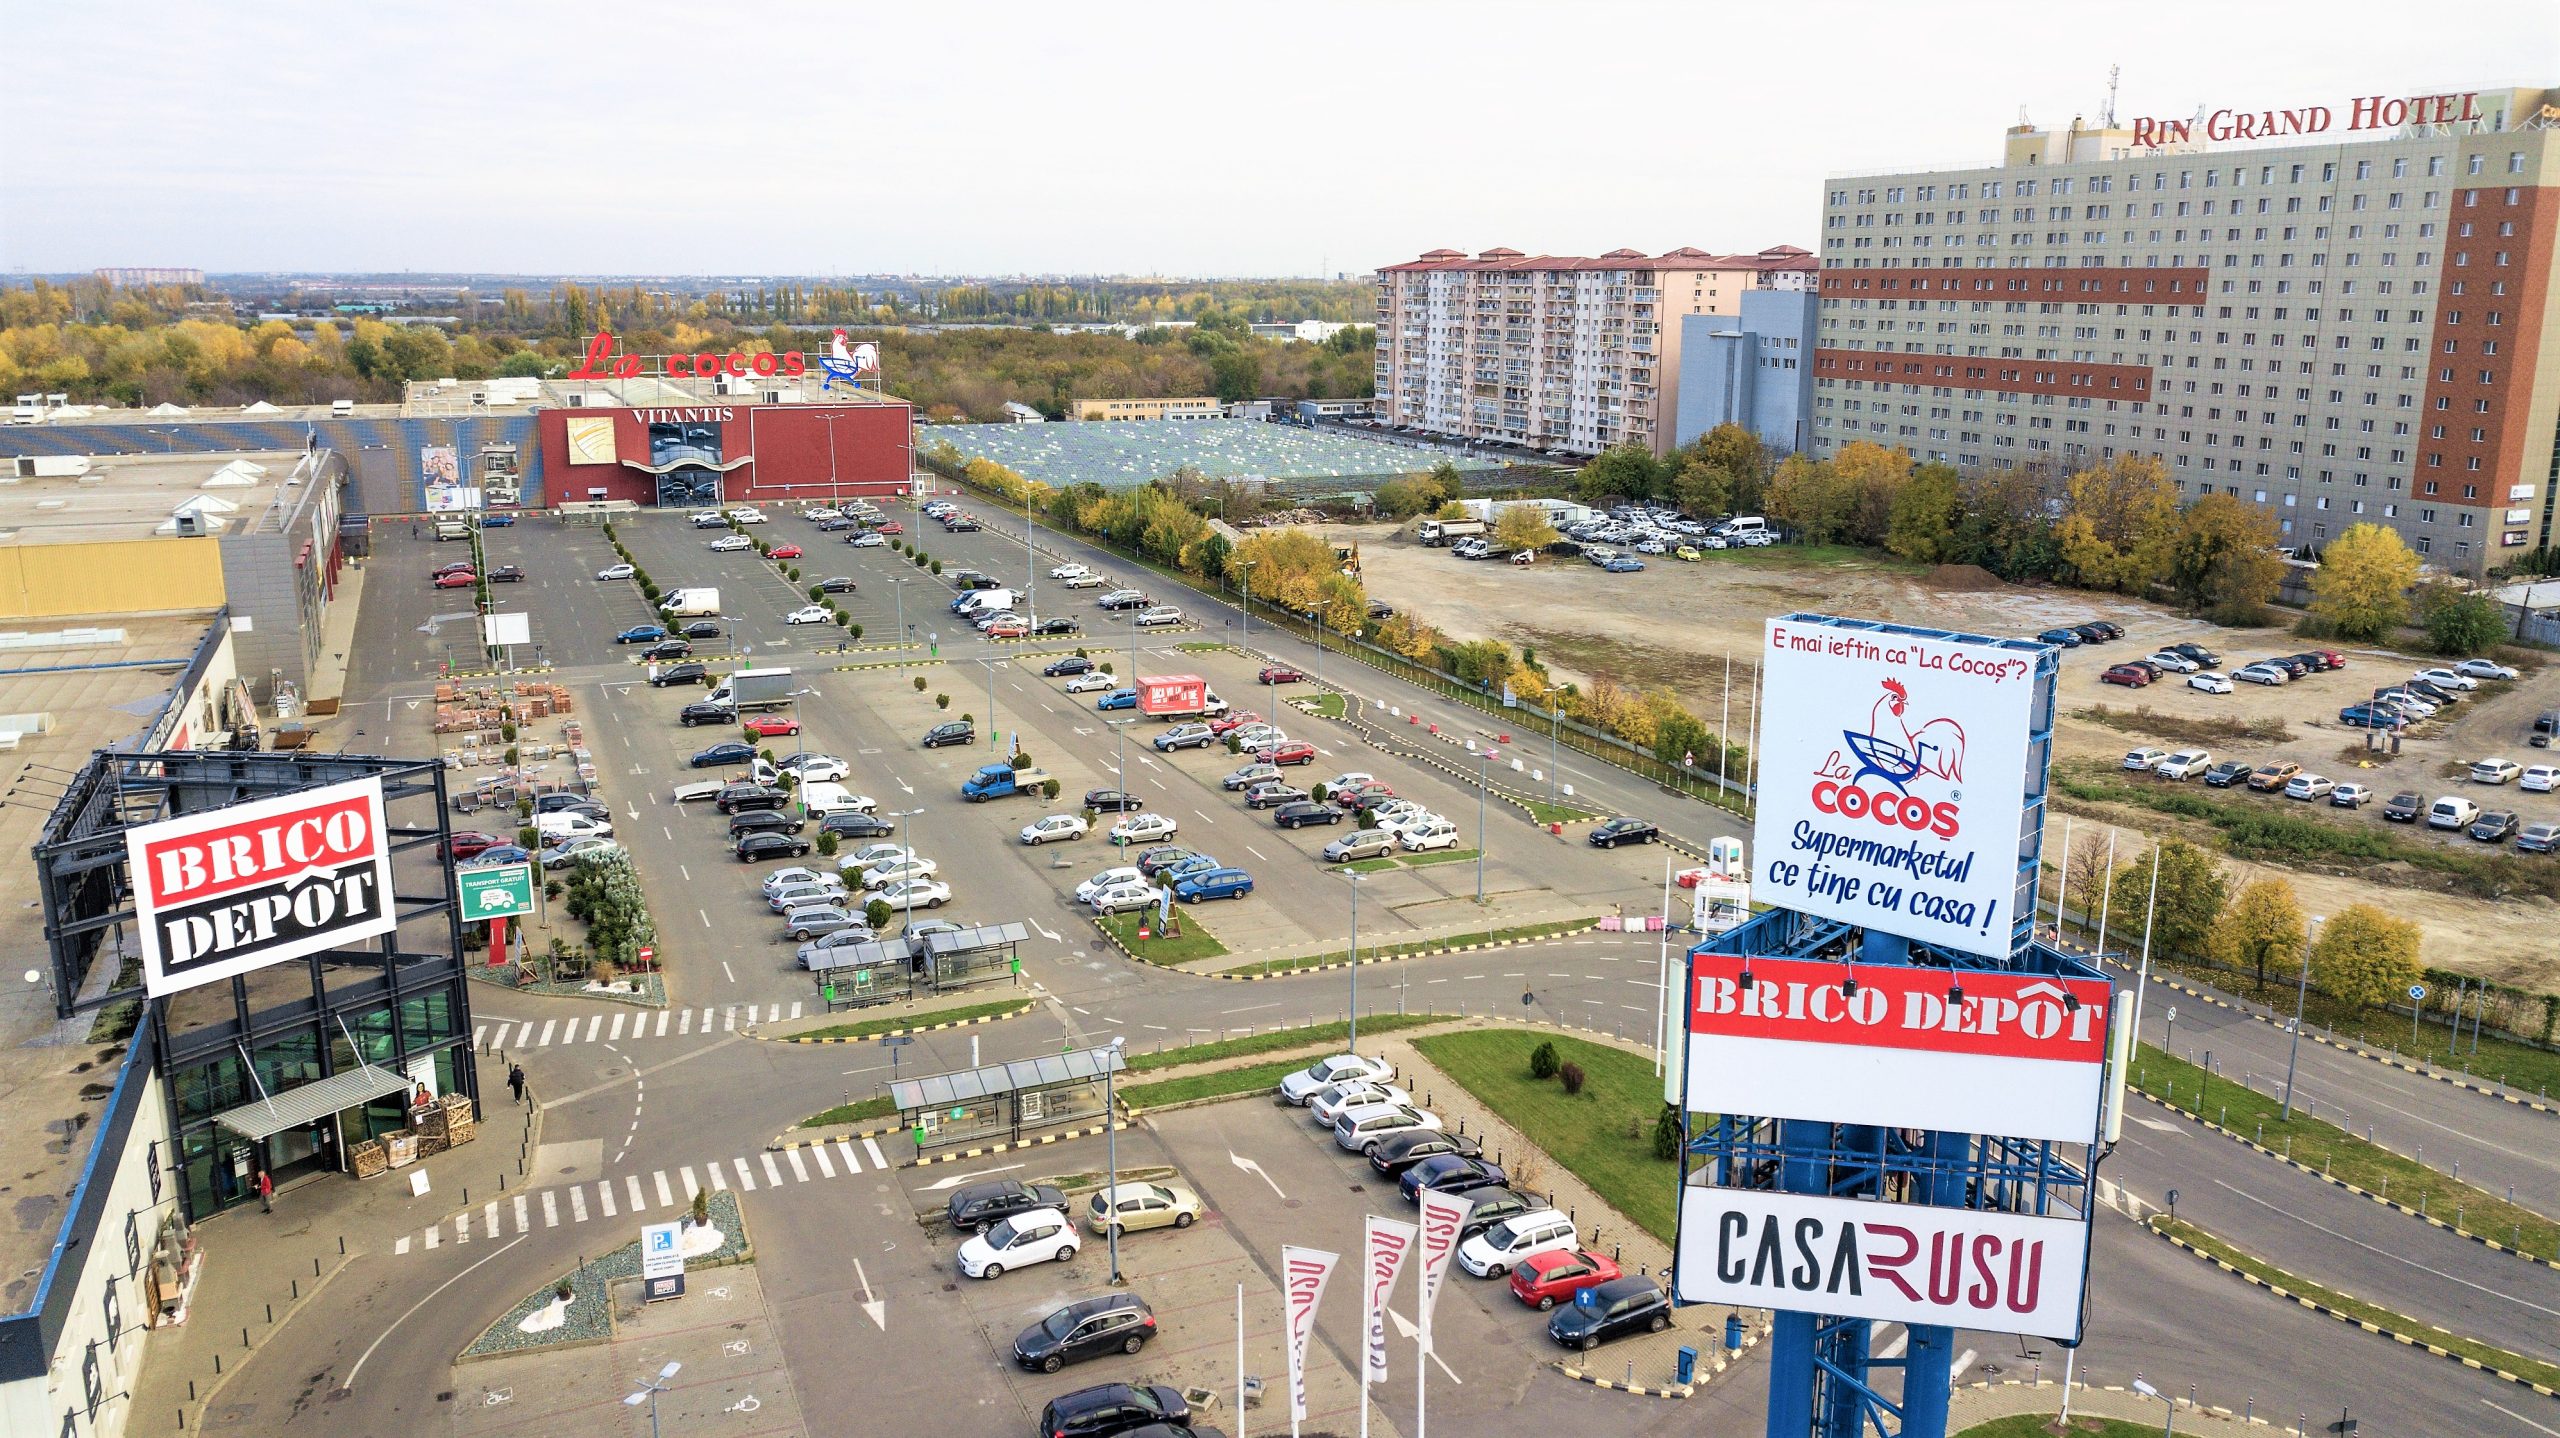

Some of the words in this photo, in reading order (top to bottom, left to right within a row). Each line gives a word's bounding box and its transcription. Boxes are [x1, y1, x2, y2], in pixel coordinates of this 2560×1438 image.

[2132, 117, 2193, 148] RIN
[2207, 107, 2331, 142] GRAND
[2347, 92, 2483, 131] HOTEL
[568, 331, 645, 380] La
[632, 407, 734, 424] VITANTIS
[1772, 627, 1787, 649] E
[1790, 634, 1823, 653] mai
[1828, 636, 1881, 662] ieftin
[1885, 647, 1907, 665] ca
[1813, 750, 1852, 780] La
[156, 810, 368, 897] BRICO
[1791, 820, 1975, 884] Supermarketul
[464, 878, 500, 888] TRANSPORT
[500, 875, 525, 884] GRATUIT
[1769, 860, 1800, 887] ce
[1867, 882, 1903, 912] cu
[1909, 891, 1977, 928] casa
[164, 865, 374, 965] DEPÔT
[1697, 976, 1888, 1027] BRICO
[1902, 981, 2103, 1043] DEPÔT
